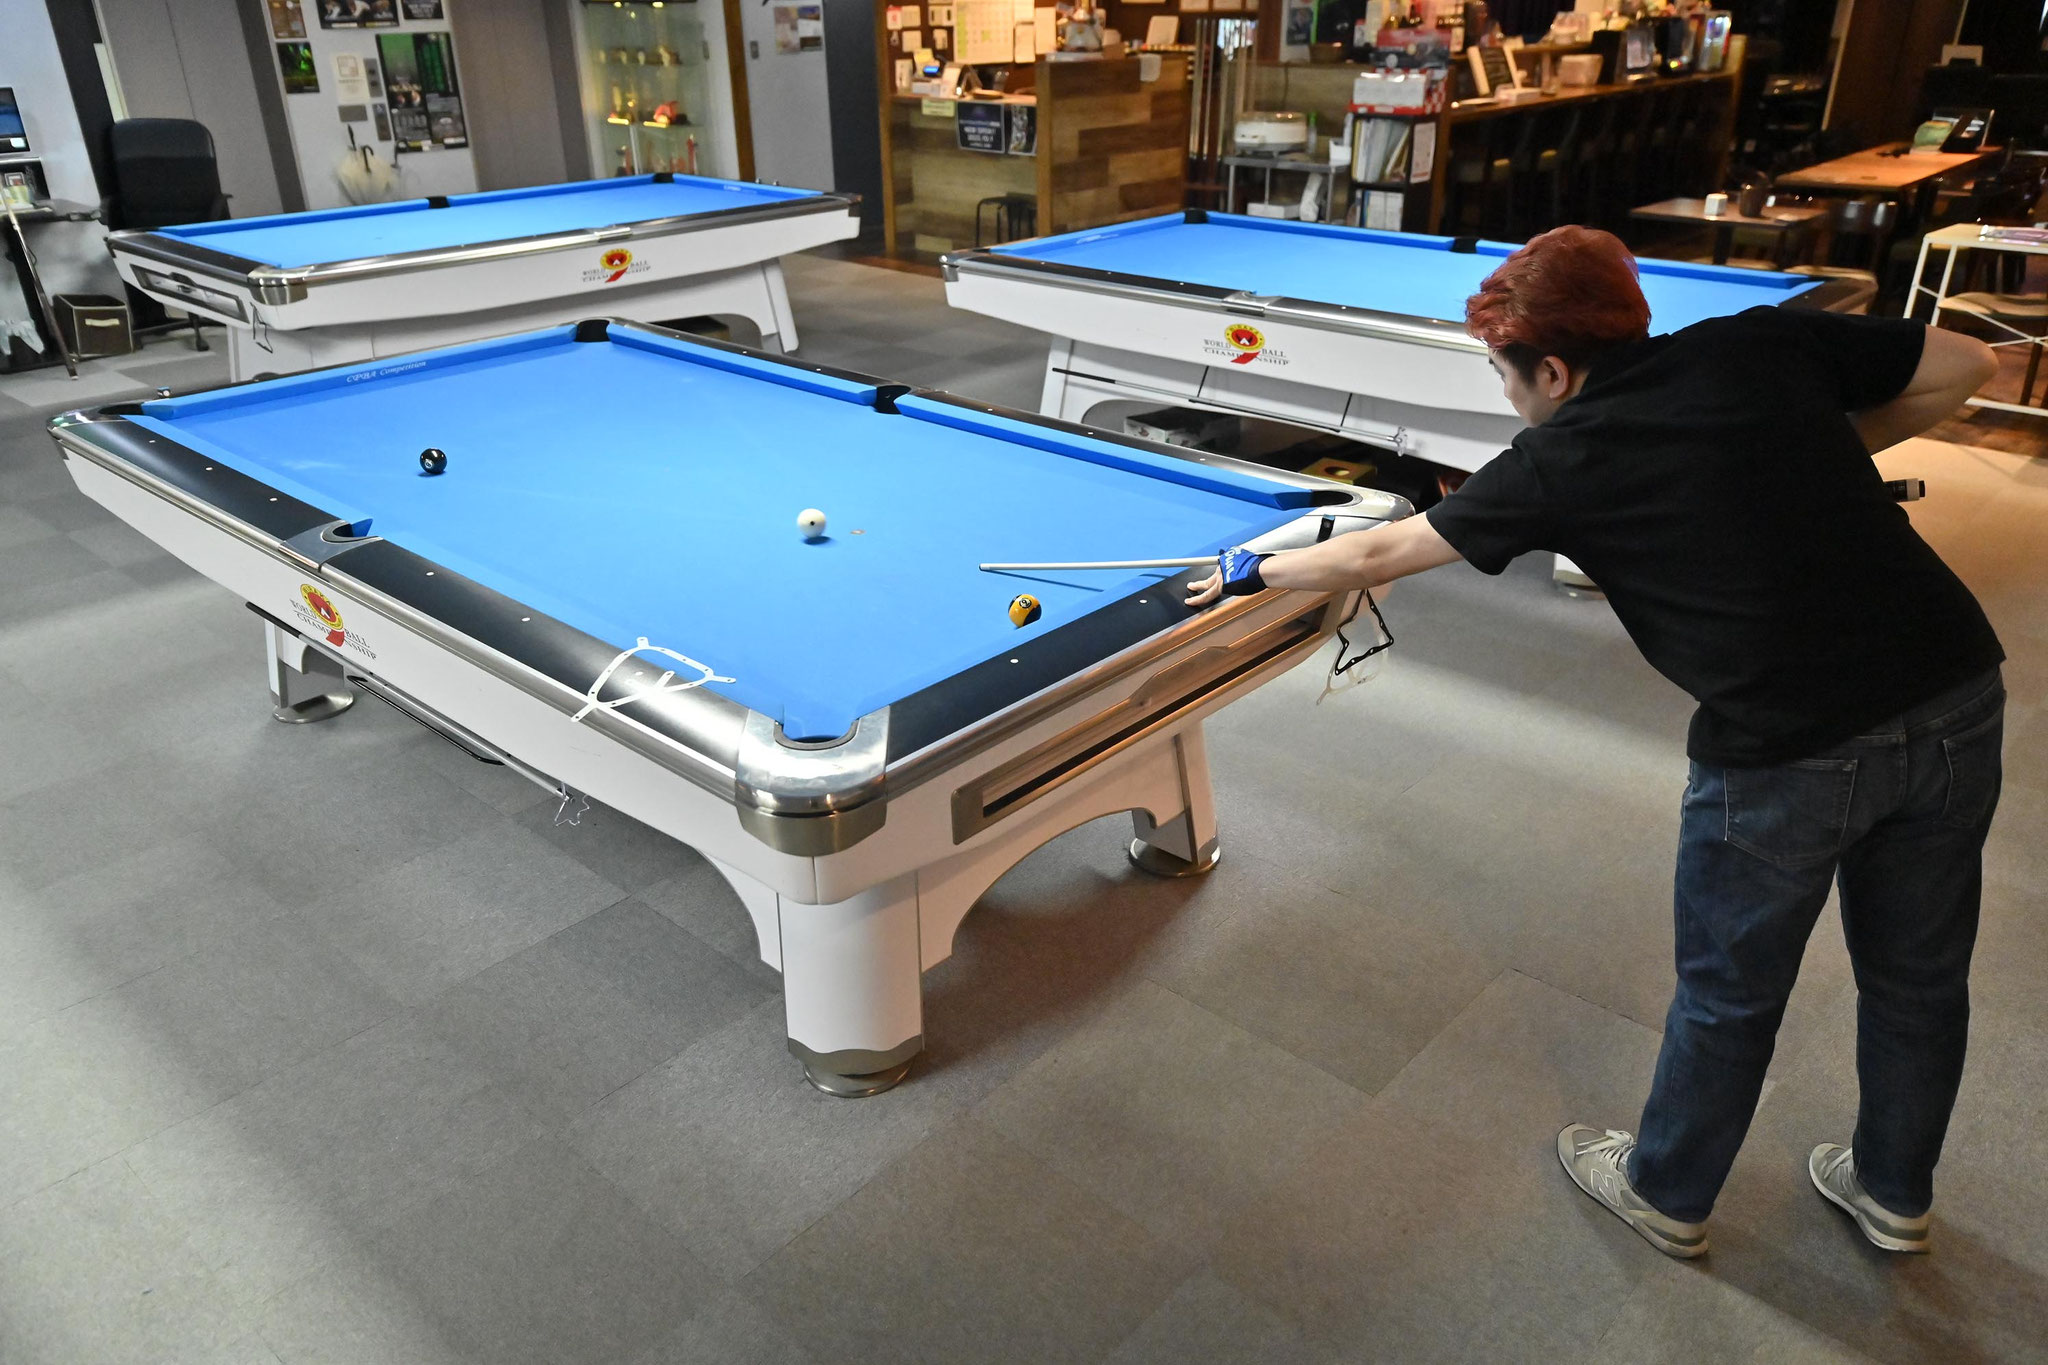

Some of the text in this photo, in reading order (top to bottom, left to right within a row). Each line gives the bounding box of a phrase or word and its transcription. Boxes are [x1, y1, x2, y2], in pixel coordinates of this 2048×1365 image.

[1203, 339, 1232, 349] WORLD
[1261, 348, 1286, 358] BALL
[379, 361, 427, 376] Competition
[343, 627, 371, 648] BALL
